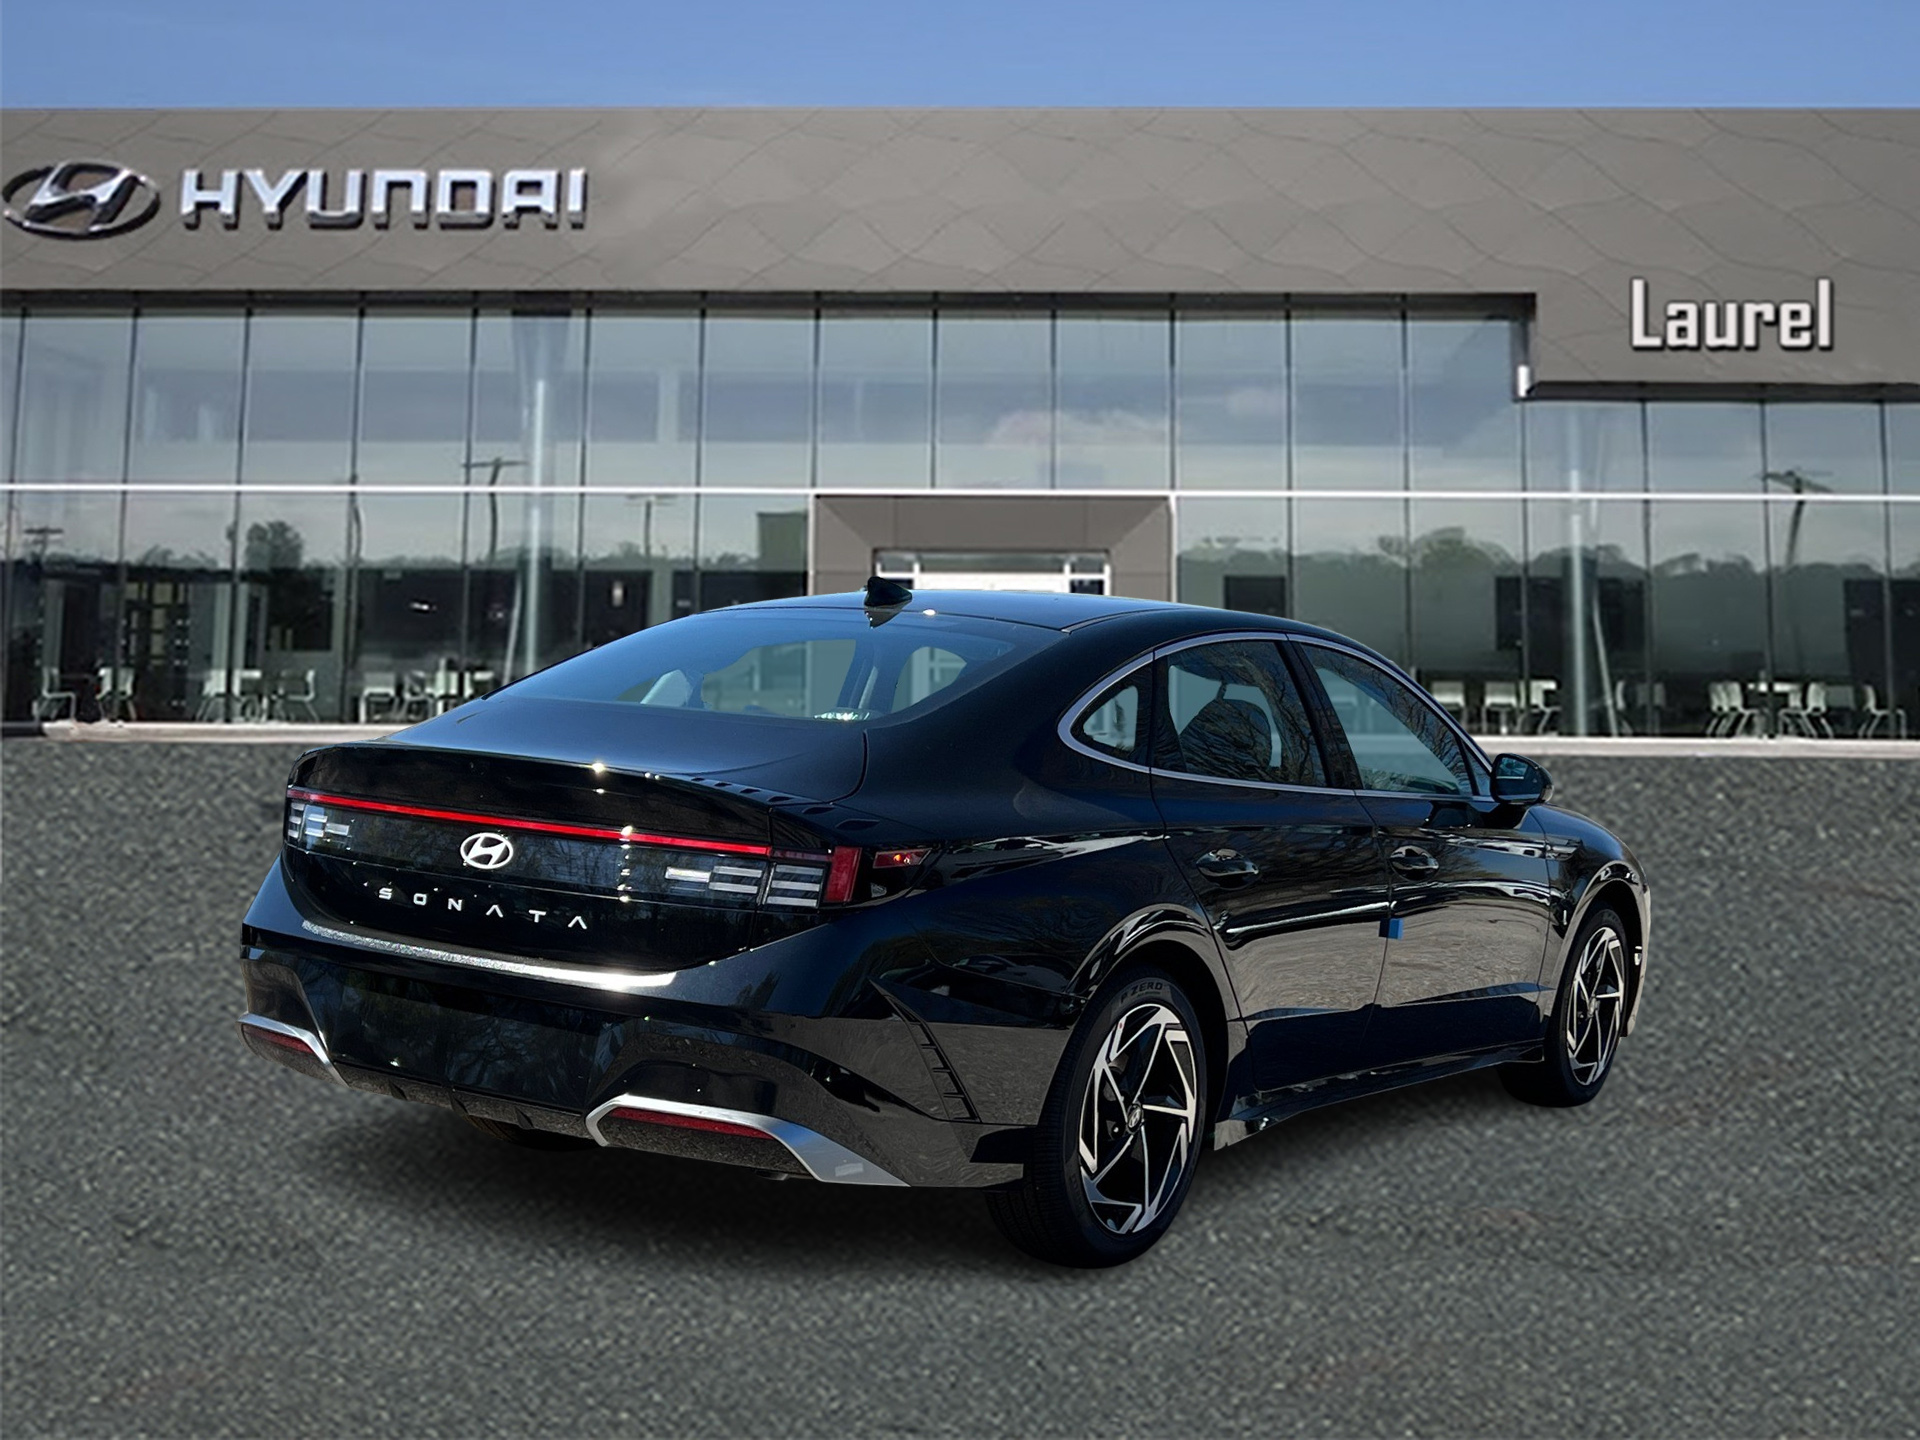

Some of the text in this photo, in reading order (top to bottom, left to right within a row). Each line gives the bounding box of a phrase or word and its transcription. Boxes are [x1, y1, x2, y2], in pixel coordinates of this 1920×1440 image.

[180, 168, 587, 228] HYUNDAI
[1631, 278, 1832, 348] Laurel
[378, 886, 588, 930] SONATA
